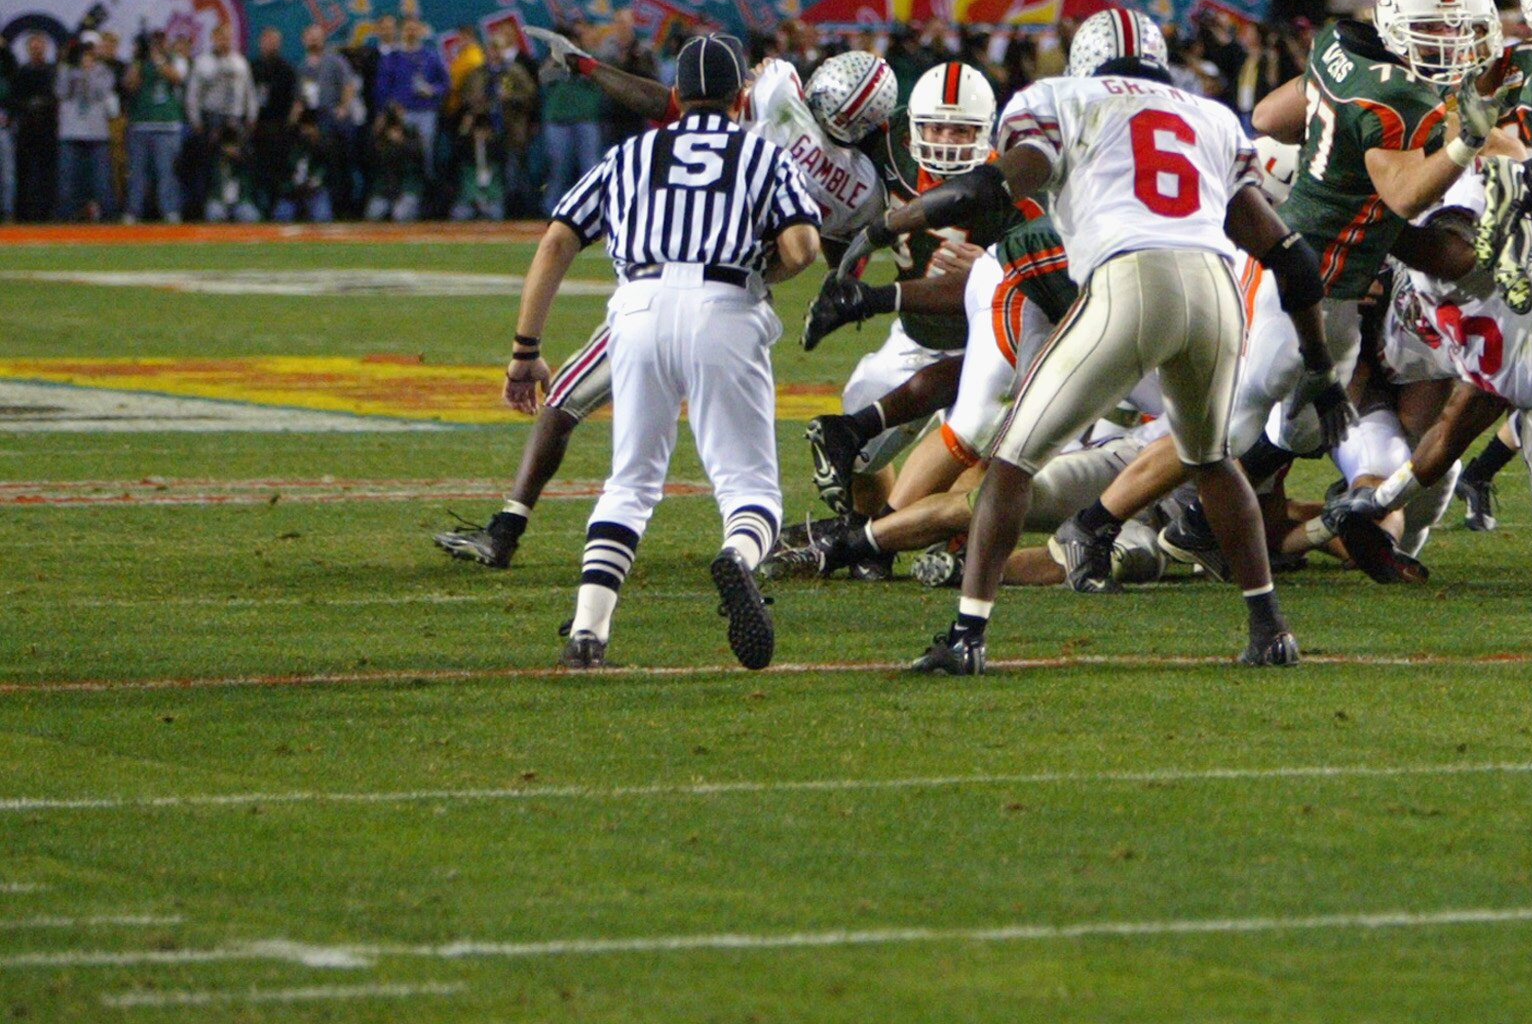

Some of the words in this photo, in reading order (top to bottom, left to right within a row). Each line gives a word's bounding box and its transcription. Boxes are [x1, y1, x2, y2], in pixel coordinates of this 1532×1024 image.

[668, 132, 729, 187] S
[790, 134, 868, 210] GAMBLE
[1129, 108, 1201, 218] 6
